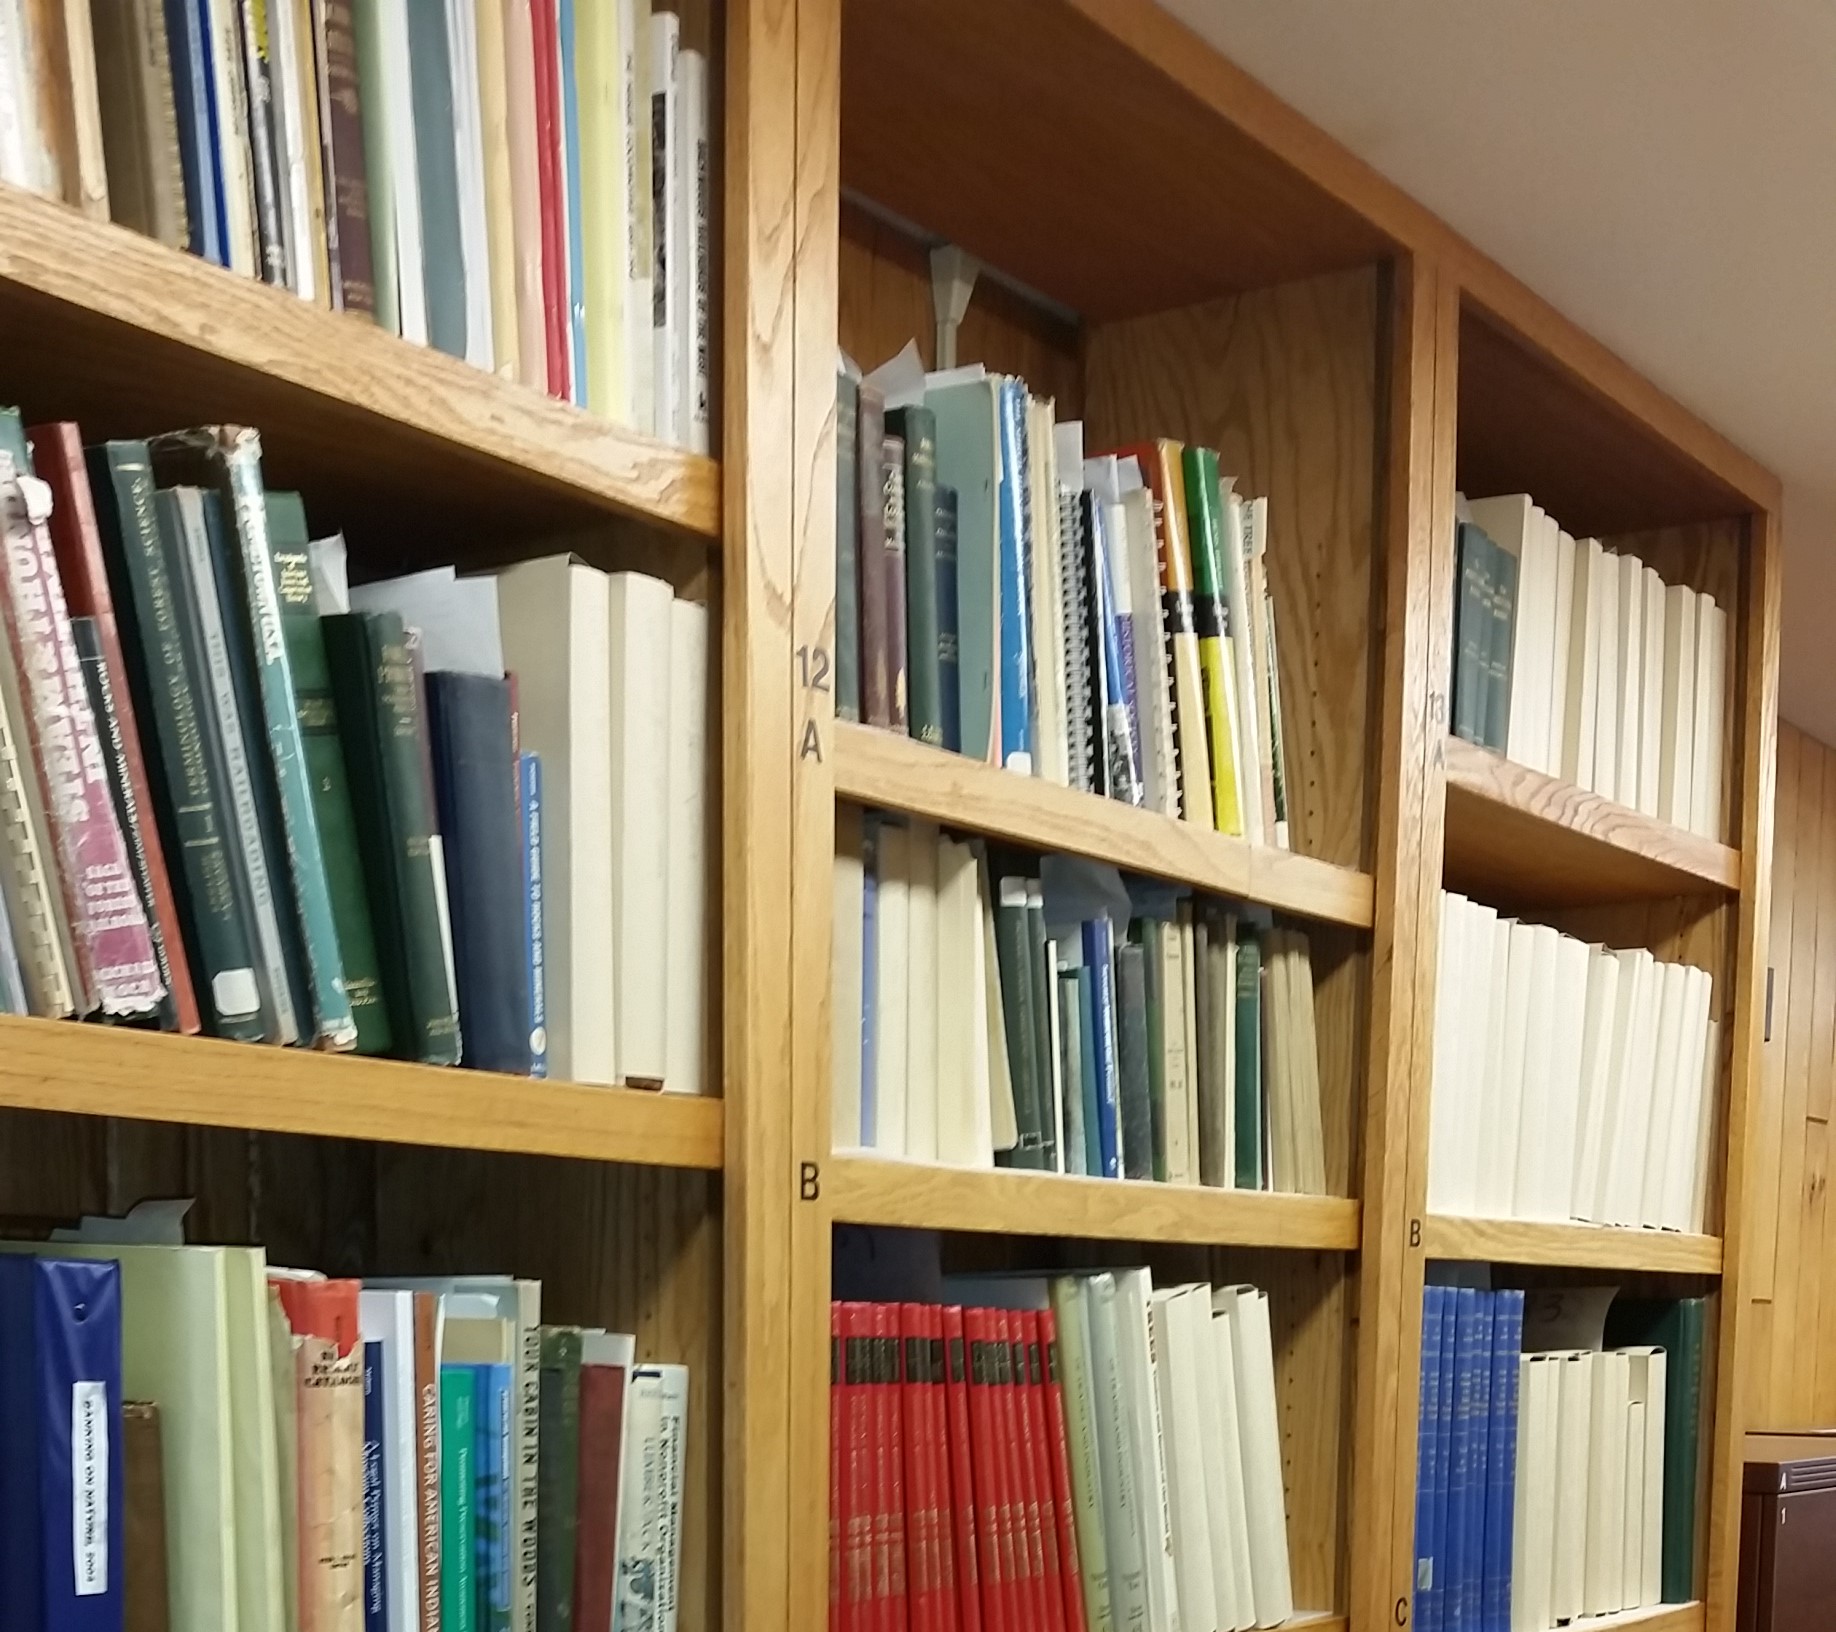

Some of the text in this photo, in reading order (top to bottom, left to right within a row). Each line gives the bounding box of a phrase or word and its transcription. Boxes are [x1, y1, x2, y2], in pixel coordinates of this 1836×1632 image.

[148, 568, 168, 631] FOREST
[26, 641, 57, 673] &
[797, 645, 830, 694] 12
[97, 661, 113, 713] ROCKS
[108, 716, 124, 750] AND
[1428, 691, 1445, 723] 13
[32, 676, 89, 822] STEAM
[800, 717, 822, 763] A
[1432, 745, 1445, 767] A
[230, 746, 269, 909] RAILROADING
[799, 1162, 820, 1202] B
[1410, 1218, 1422, 1249] B
[523, 1324, 541, 1373] YOUR
[422, 1383, 438, 1448] CARING
[523, 1380, 539, 1438] CABIN
[660, 1416, 670, 1433] in
[84, 1466, 96, 1486] ON
[423, 1452, 438, 1486] FOR
[523, 1444, 538, 1466] IN
[522, 1474, 538, 1511] THE
[657, 1438, 671, 1520] Nonprofit
[1779, 1472, 1786, 1490] A
[424, 1488, 439, 1576] AMERICAN
[668, 1415, 681, 1612] Financial Management
[1780, 1507, 1786, 1525] 1
[522, 1516, 537, 1588] WOODS
[369, 1552, 384, 1614] Managing
[1395, 1597, 1408, 1627] C
